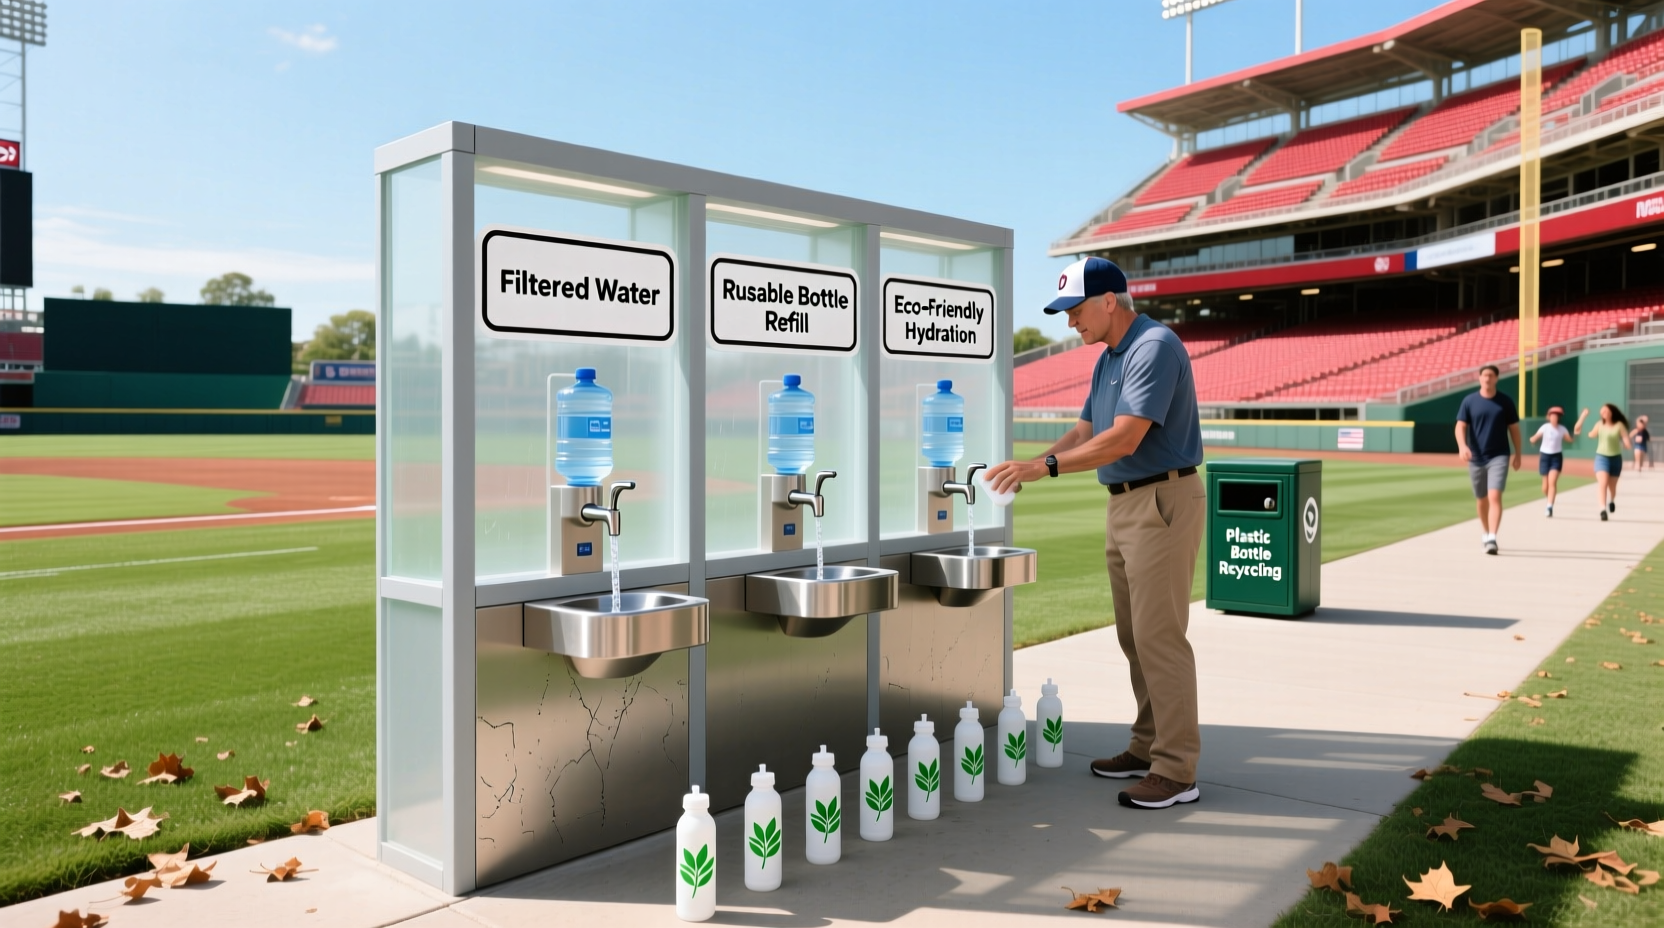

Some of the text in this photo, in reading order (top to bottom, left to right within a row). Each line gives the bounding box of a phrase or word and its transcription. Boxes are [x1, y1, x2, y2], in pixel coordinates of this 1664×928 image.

[500, 268, 661, 306] Filtered Water
[722, 278, 849, 310] Rusable Bottle
[765, 310, 809, 334] Refill
[894, 294, 985, 326] Eco-Friendly
[905, 321, 977, 346] Hydration
[1226, 526, 1271, 545] Plastic
